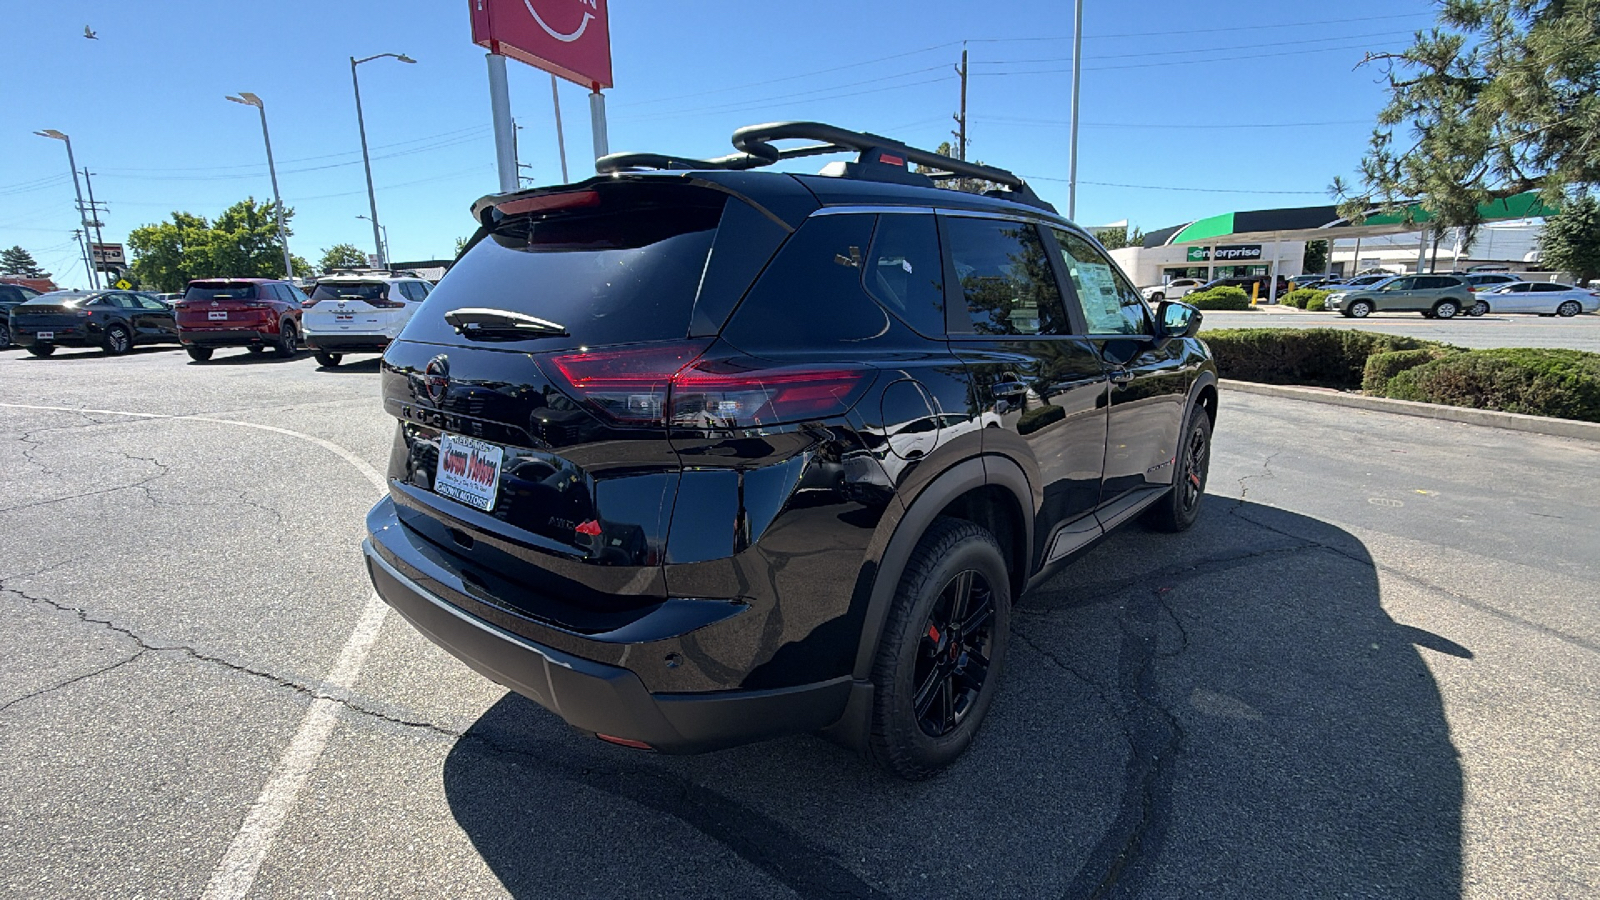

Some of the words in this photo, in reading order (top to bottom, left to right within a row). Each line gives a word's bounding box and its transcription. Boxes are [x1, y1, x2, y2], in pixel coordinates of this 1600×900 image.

[1189, 247, 1261, 259] enerprise
[402, 407, 483, 437] ROGUE
[437, 482, 460, 498] CROWN
[460, 490, 488, 508] MOTORS
